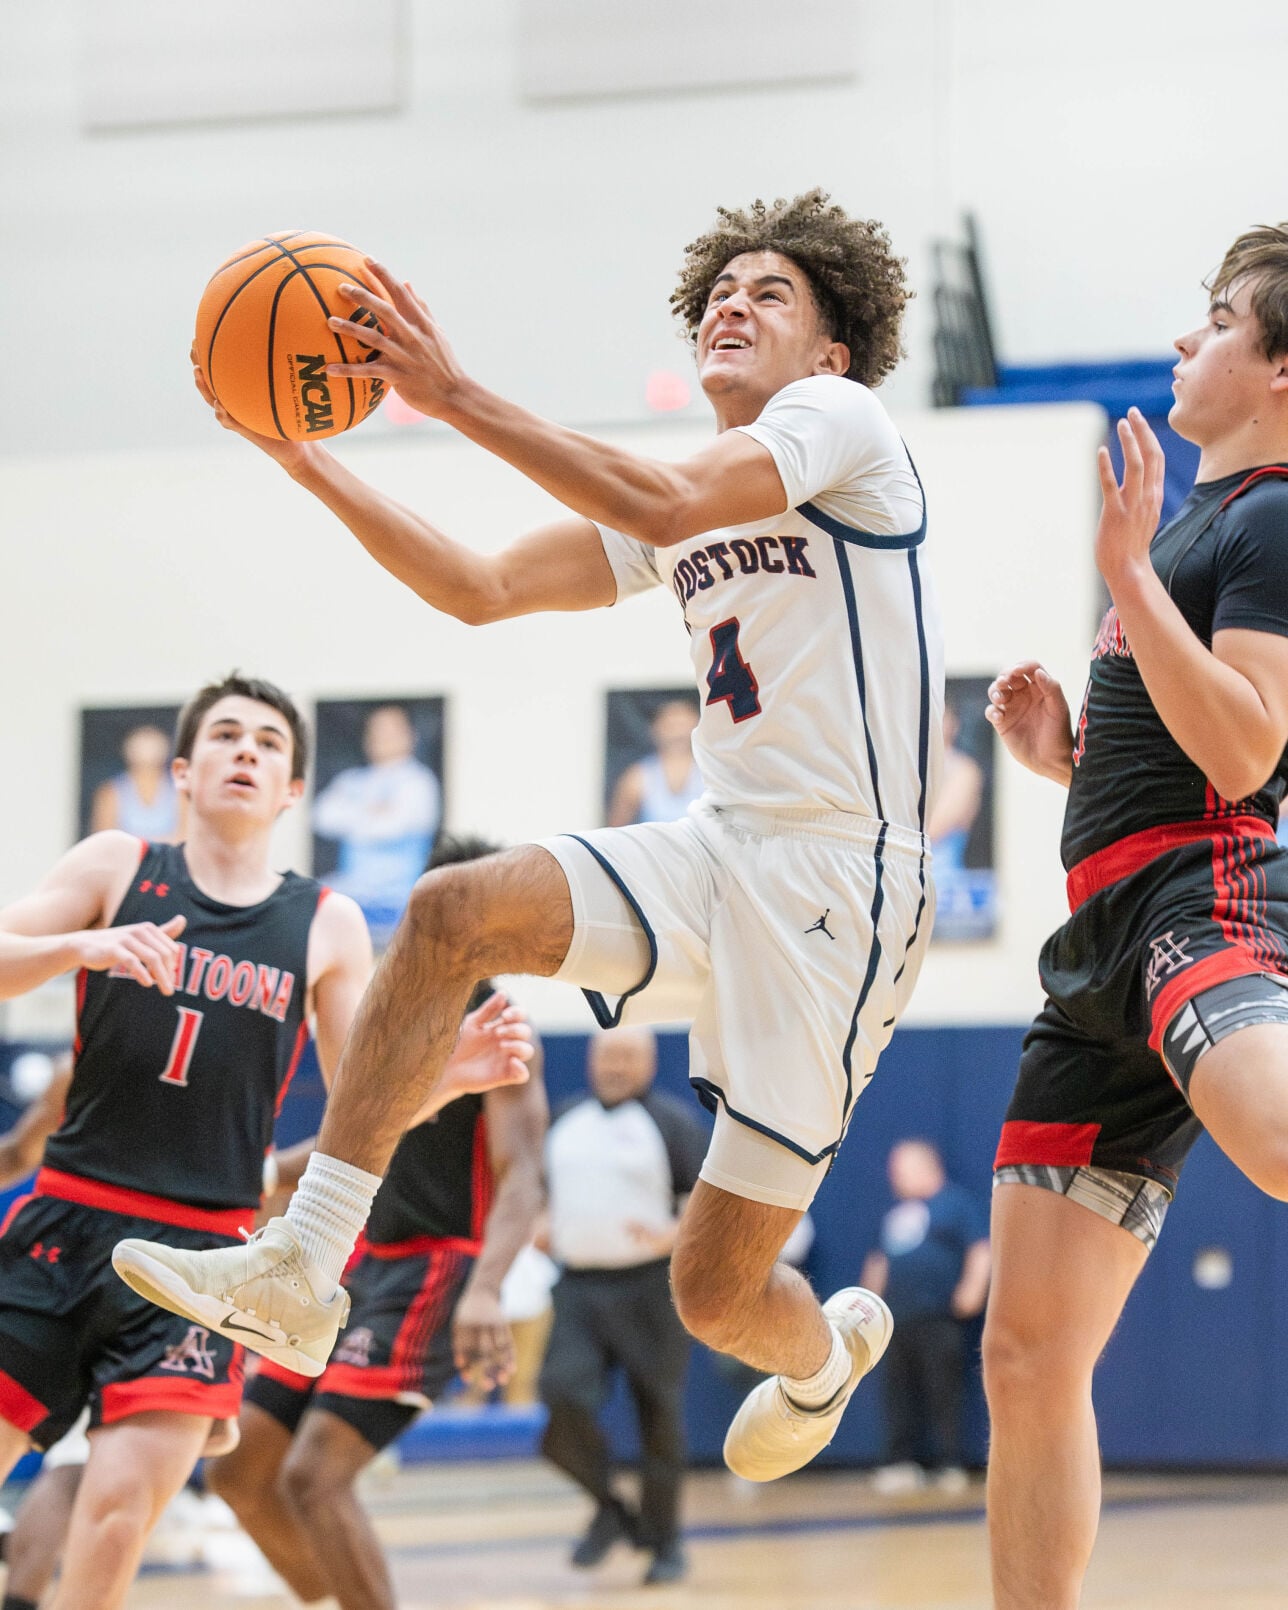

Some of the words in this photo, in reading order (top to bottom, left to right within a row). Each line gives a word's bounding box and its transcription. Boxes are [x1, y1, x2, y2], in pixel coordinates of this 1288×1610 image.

[296, 354, 334, 433] NCAA
[706, 616, 762, 724] 4
[158, 1005, 204, 1087] 1
